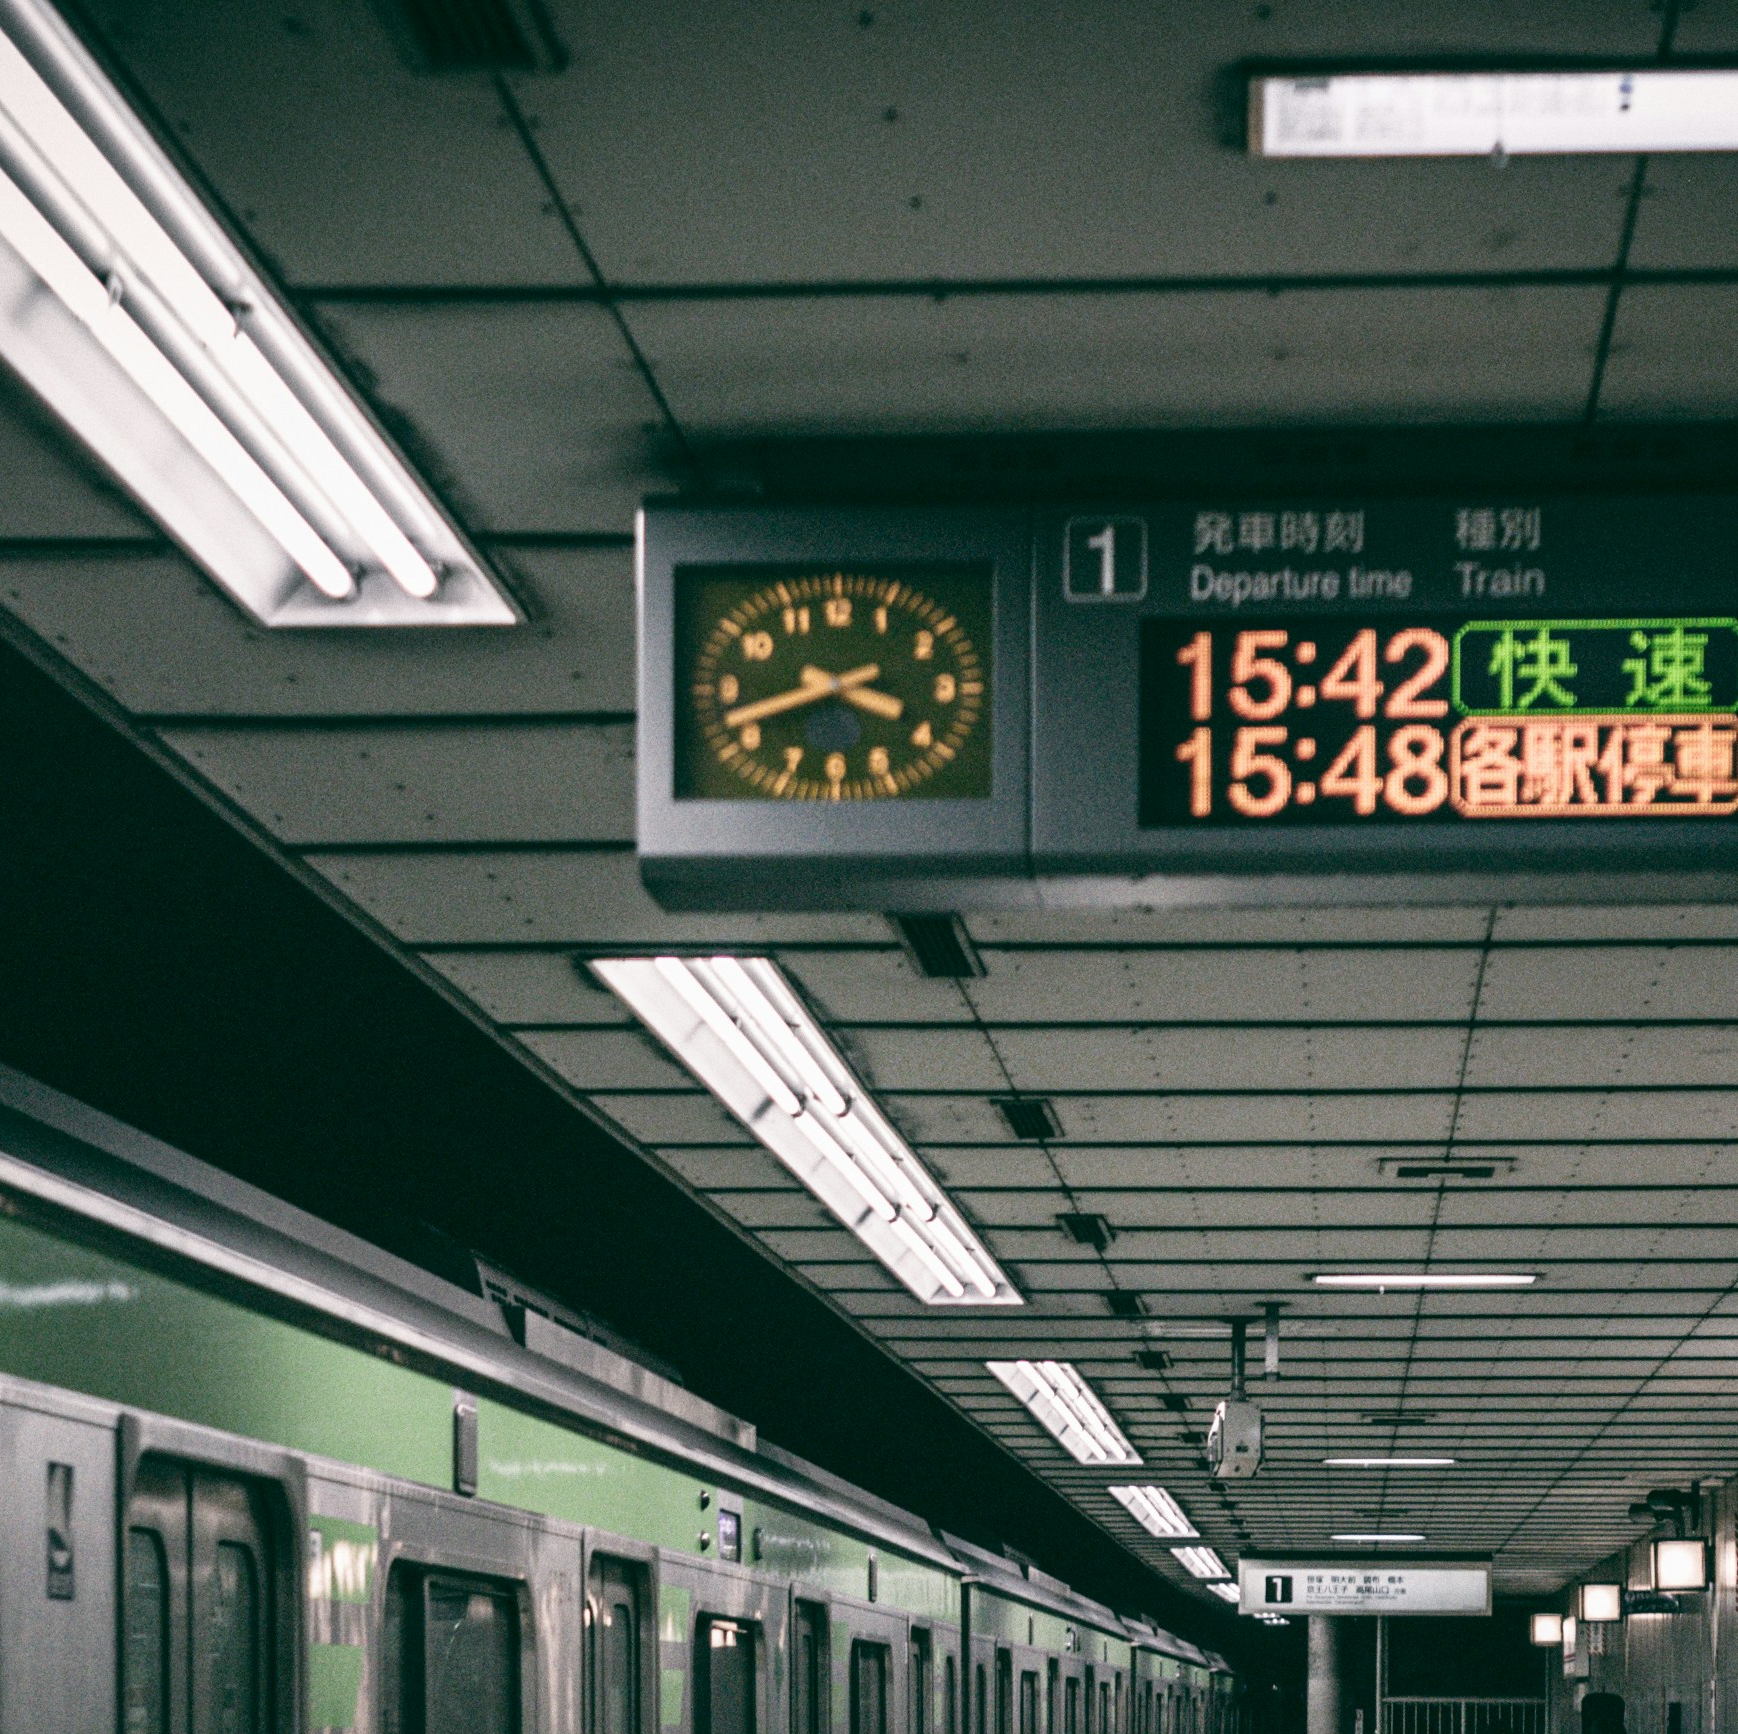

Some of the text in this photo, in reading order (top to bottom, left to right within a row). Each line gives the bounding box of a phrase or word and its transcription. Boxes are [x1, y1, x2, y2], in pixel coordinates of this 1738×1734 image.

[1192, 508, 1364, 554] 発車時刻
[1455, 506, 1542, 551] 種別
[1087, 524, 1116, 596] 1
[1455, 560, 1547, 598] Train
[1189, 562, 1414, 608] Departure time
[1174, 627, 1450, 722] 15:42
[1174, 722, 1450, 818] 15:48
[1272, 1577, 1284, 1602] 1
